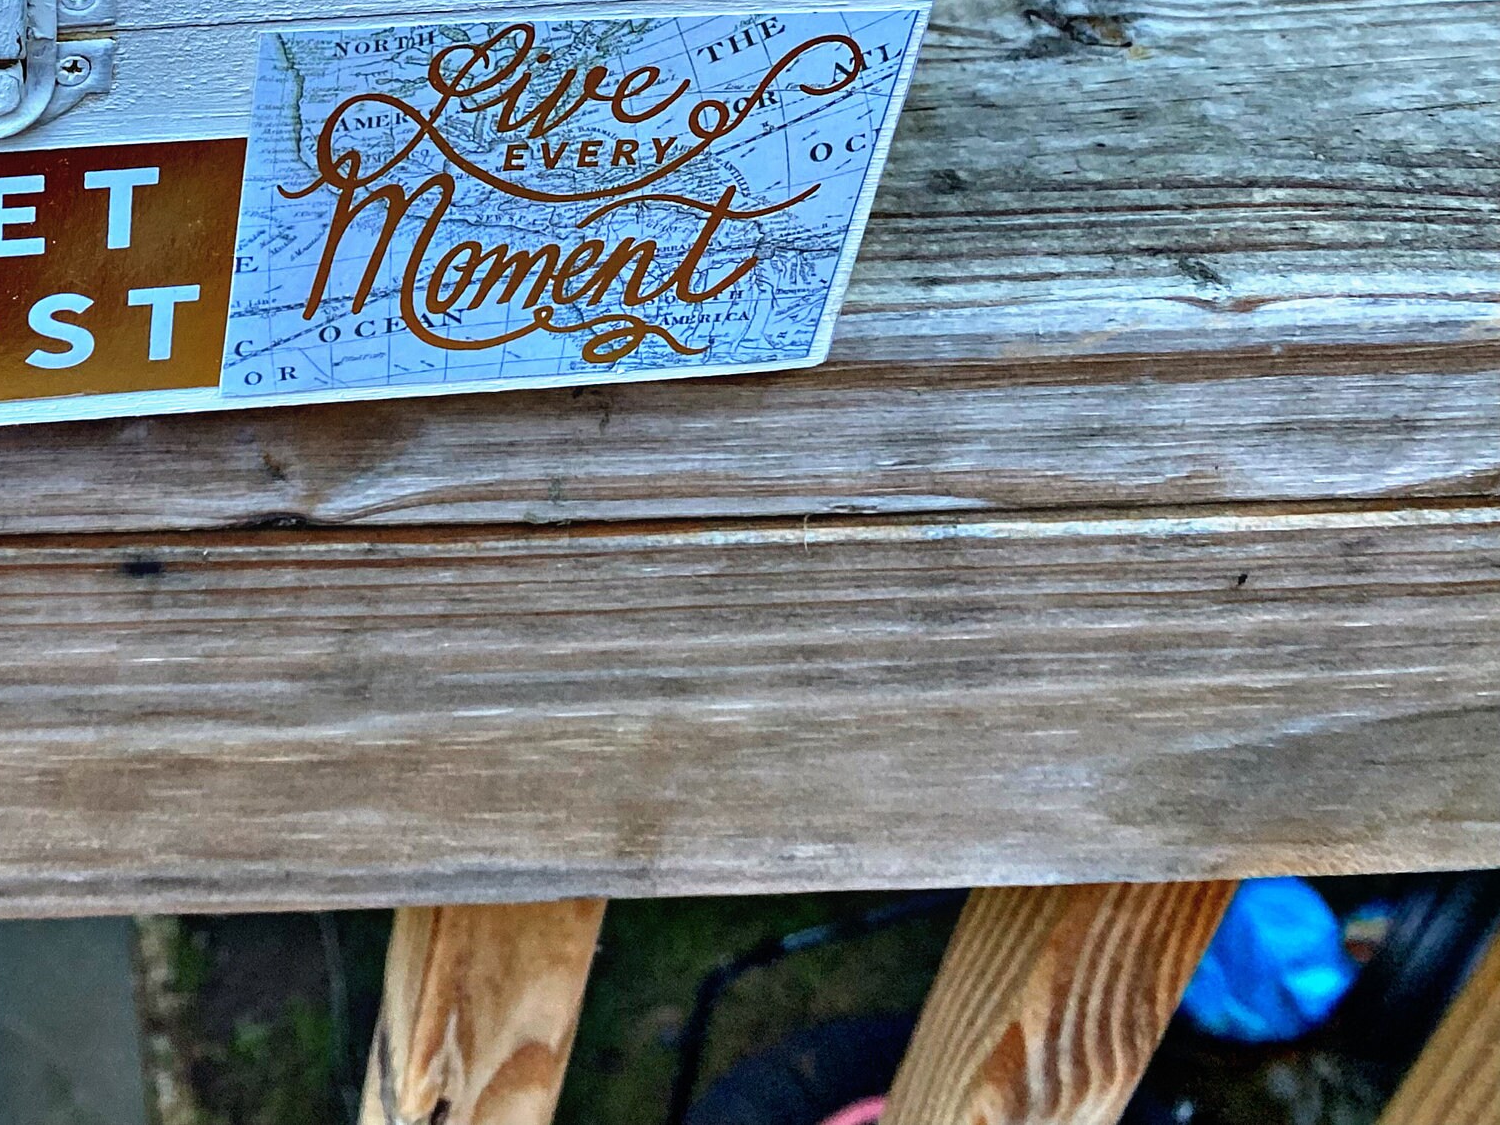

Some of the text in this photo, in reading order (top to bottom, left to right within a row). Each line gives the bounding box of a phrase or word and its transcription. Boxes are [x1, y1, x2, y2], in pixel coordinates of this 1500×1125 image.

[332, 31, 436, 57] NORTH
[696, 16, 787, 65] THE
[503, 137, 677, 171] EVERY
[303, 151, 762, 345] Moment
[244, 365, 298, 387] OR
